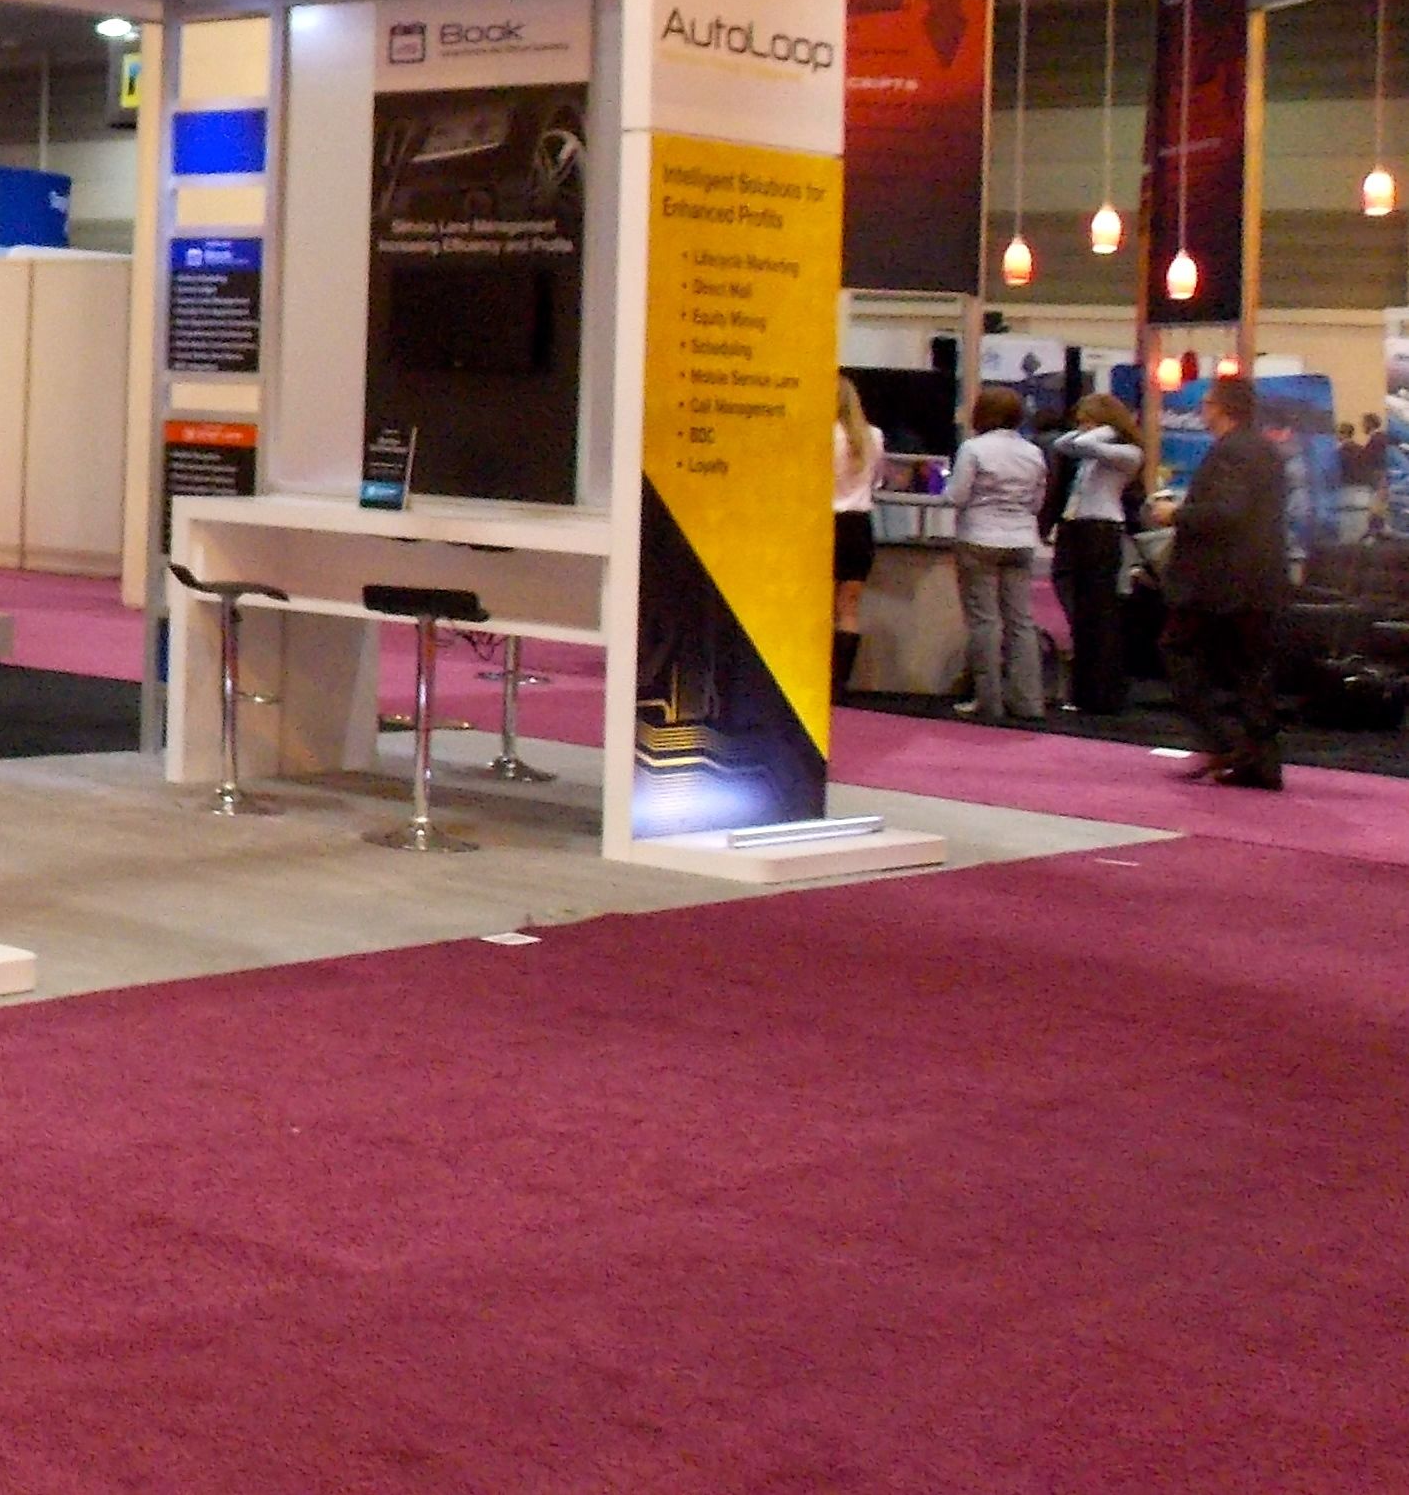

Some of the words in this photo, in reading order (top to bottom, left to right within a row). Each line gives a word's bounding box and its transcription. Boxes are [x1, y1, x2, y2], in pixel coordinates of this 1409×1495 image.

[440, 20, 526, 45] Book
[661, 7, 834, 72] AutoLoop
[662, 195, 734, 223] Enhanced
